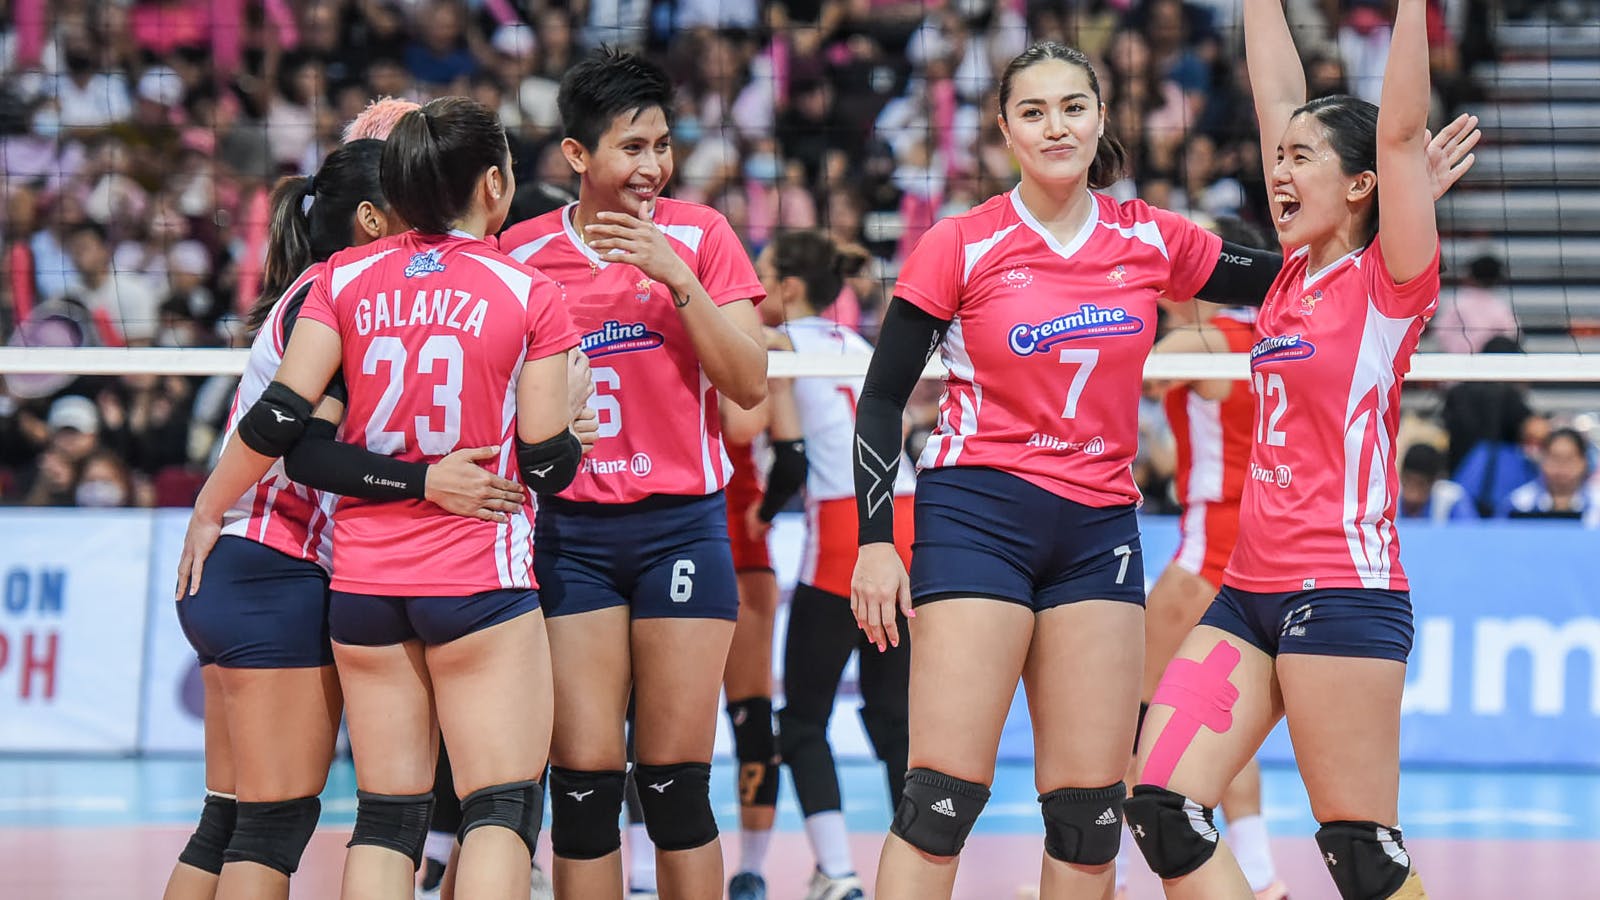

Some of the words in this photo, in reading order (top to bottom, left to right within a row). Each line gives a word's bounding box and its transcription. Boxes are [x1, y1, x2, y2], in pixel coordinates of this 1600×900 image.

[355, 288, 489, 338] GALANZA
[1010, 305, 1126, 355] Creamline
[362, 335, 464, 456] 23
[588, 366, 622, 438] 6
[1059, 348, 1101, 420] 7
[1253, 371, 1288, 447] 12
[669, 559, 696, 603] 6
[1113, 545, 1132, 585] 7
[4, 568, 67, 615] ON
[931, 804, 957, 818] adidas
[1095, 817, 1118, 825] adidas
